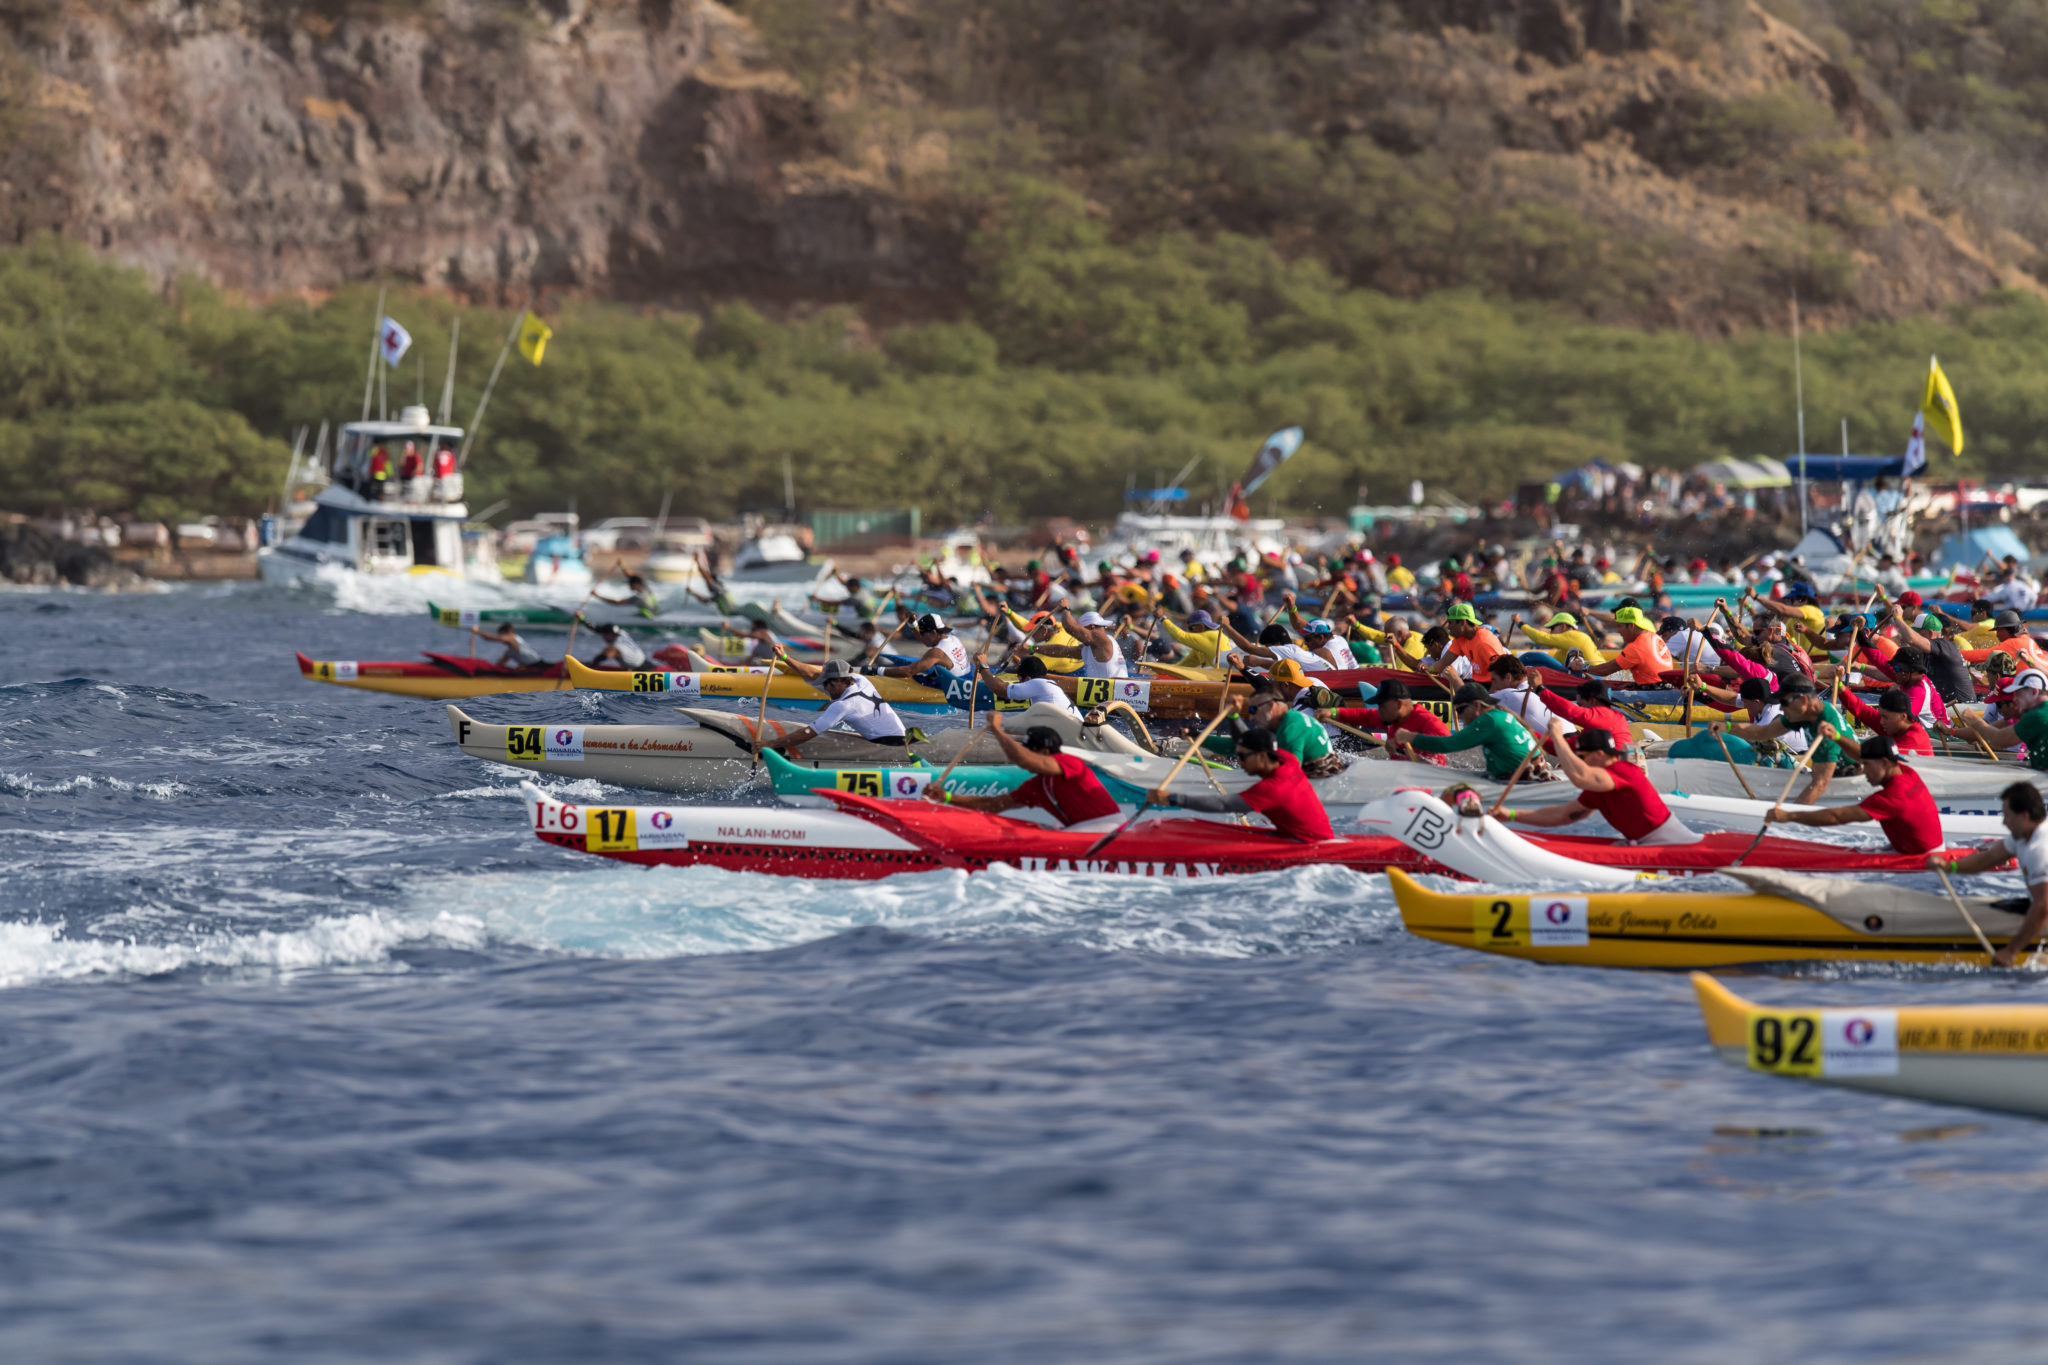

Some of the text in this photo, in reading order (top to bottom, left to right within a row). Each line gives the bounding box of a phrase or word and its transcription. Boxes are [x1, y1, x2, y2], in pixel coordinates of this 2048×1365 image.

[319, 662, 330, 678] 4
[633, 673, 665, 692] 36
[946, 680, 973, 700] A9
[1082, 679, 1110, 704] 73
[458, 721, 471, 744] F
[507, 727, 541, 755] 54
[842, 773, 878, 797] 75
[595, 810, 627, 842] 17
[717, 826, 806, 840] NALANI-MOMI
[1490, 901, 1514, 938] 2
[1755, 1018, 1815, 1066] 92
